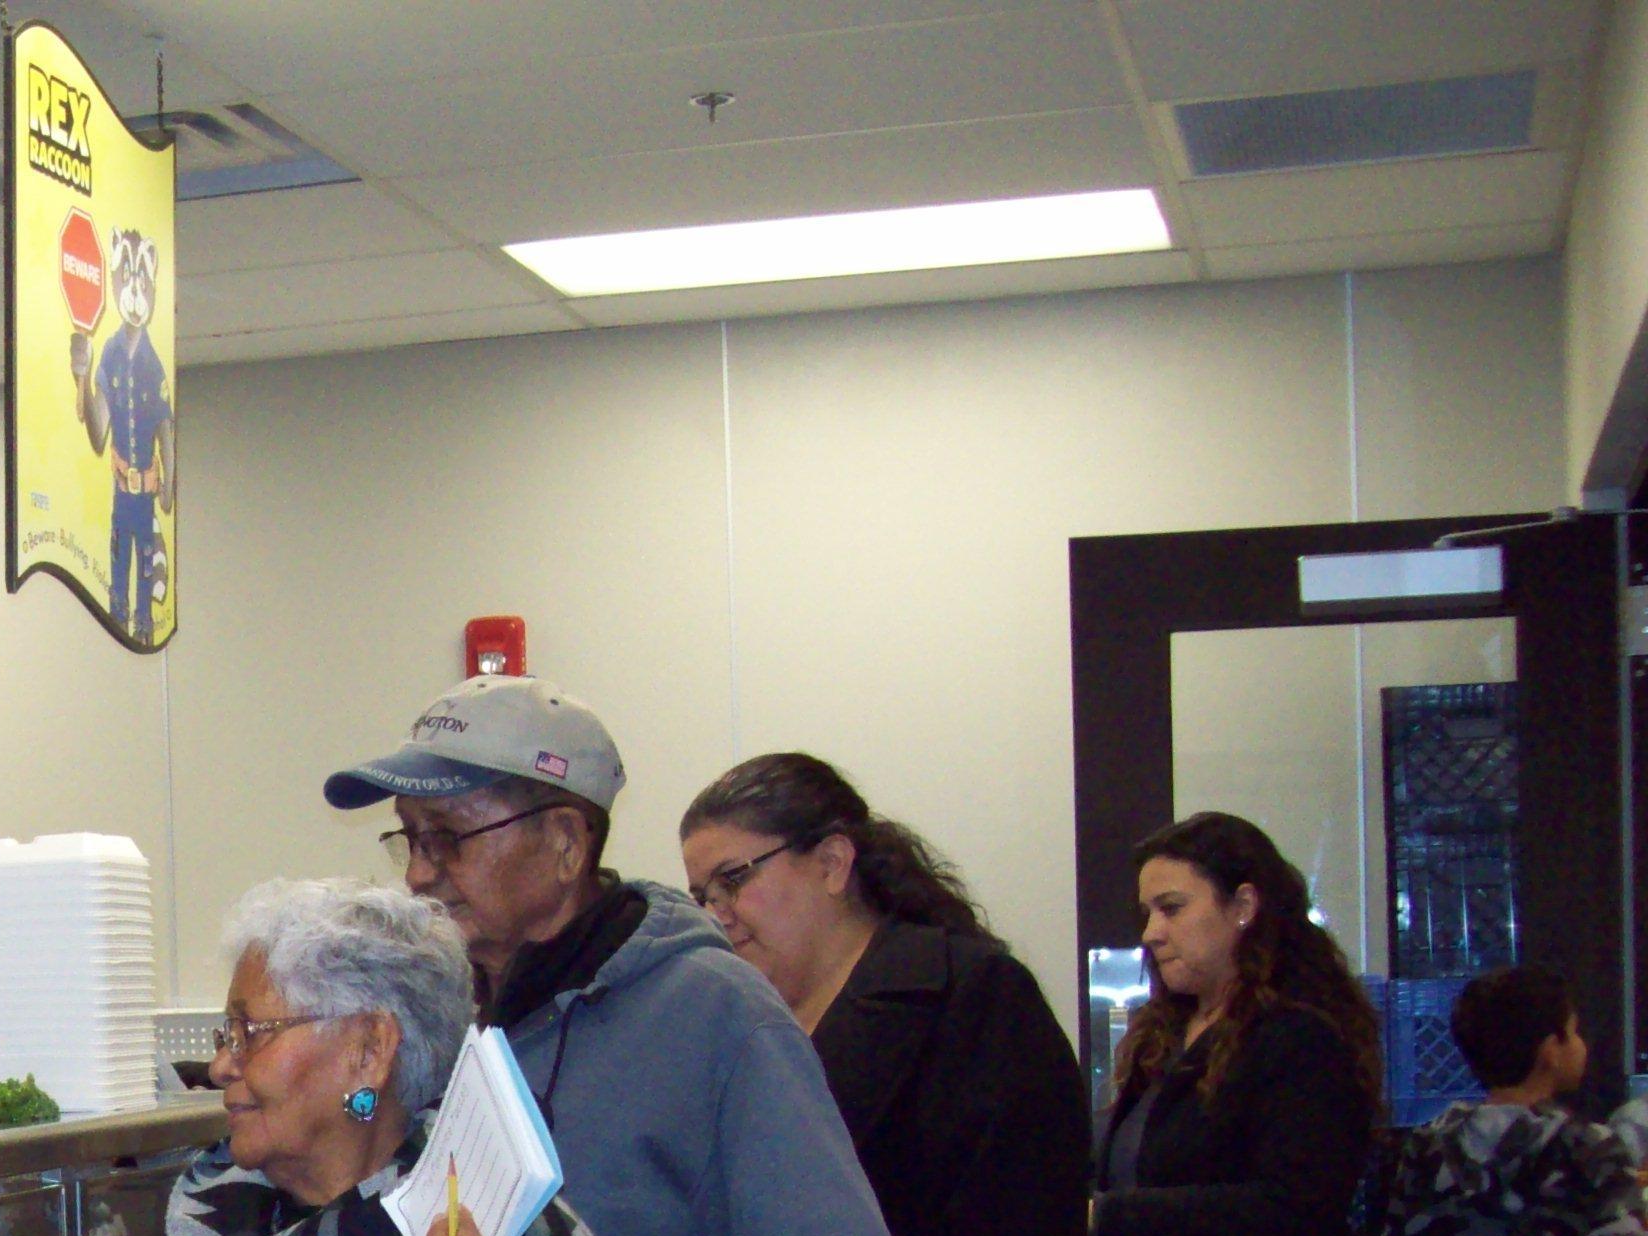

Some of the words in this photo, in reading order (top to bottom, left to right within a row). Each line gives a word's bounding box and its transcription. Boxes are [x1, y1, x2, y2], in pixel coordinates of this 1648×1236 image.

[29, 65, 91, 157] REX
[29, 135, 91, 193] RACCOON
[63, 252, 101, 286] BEWARE
